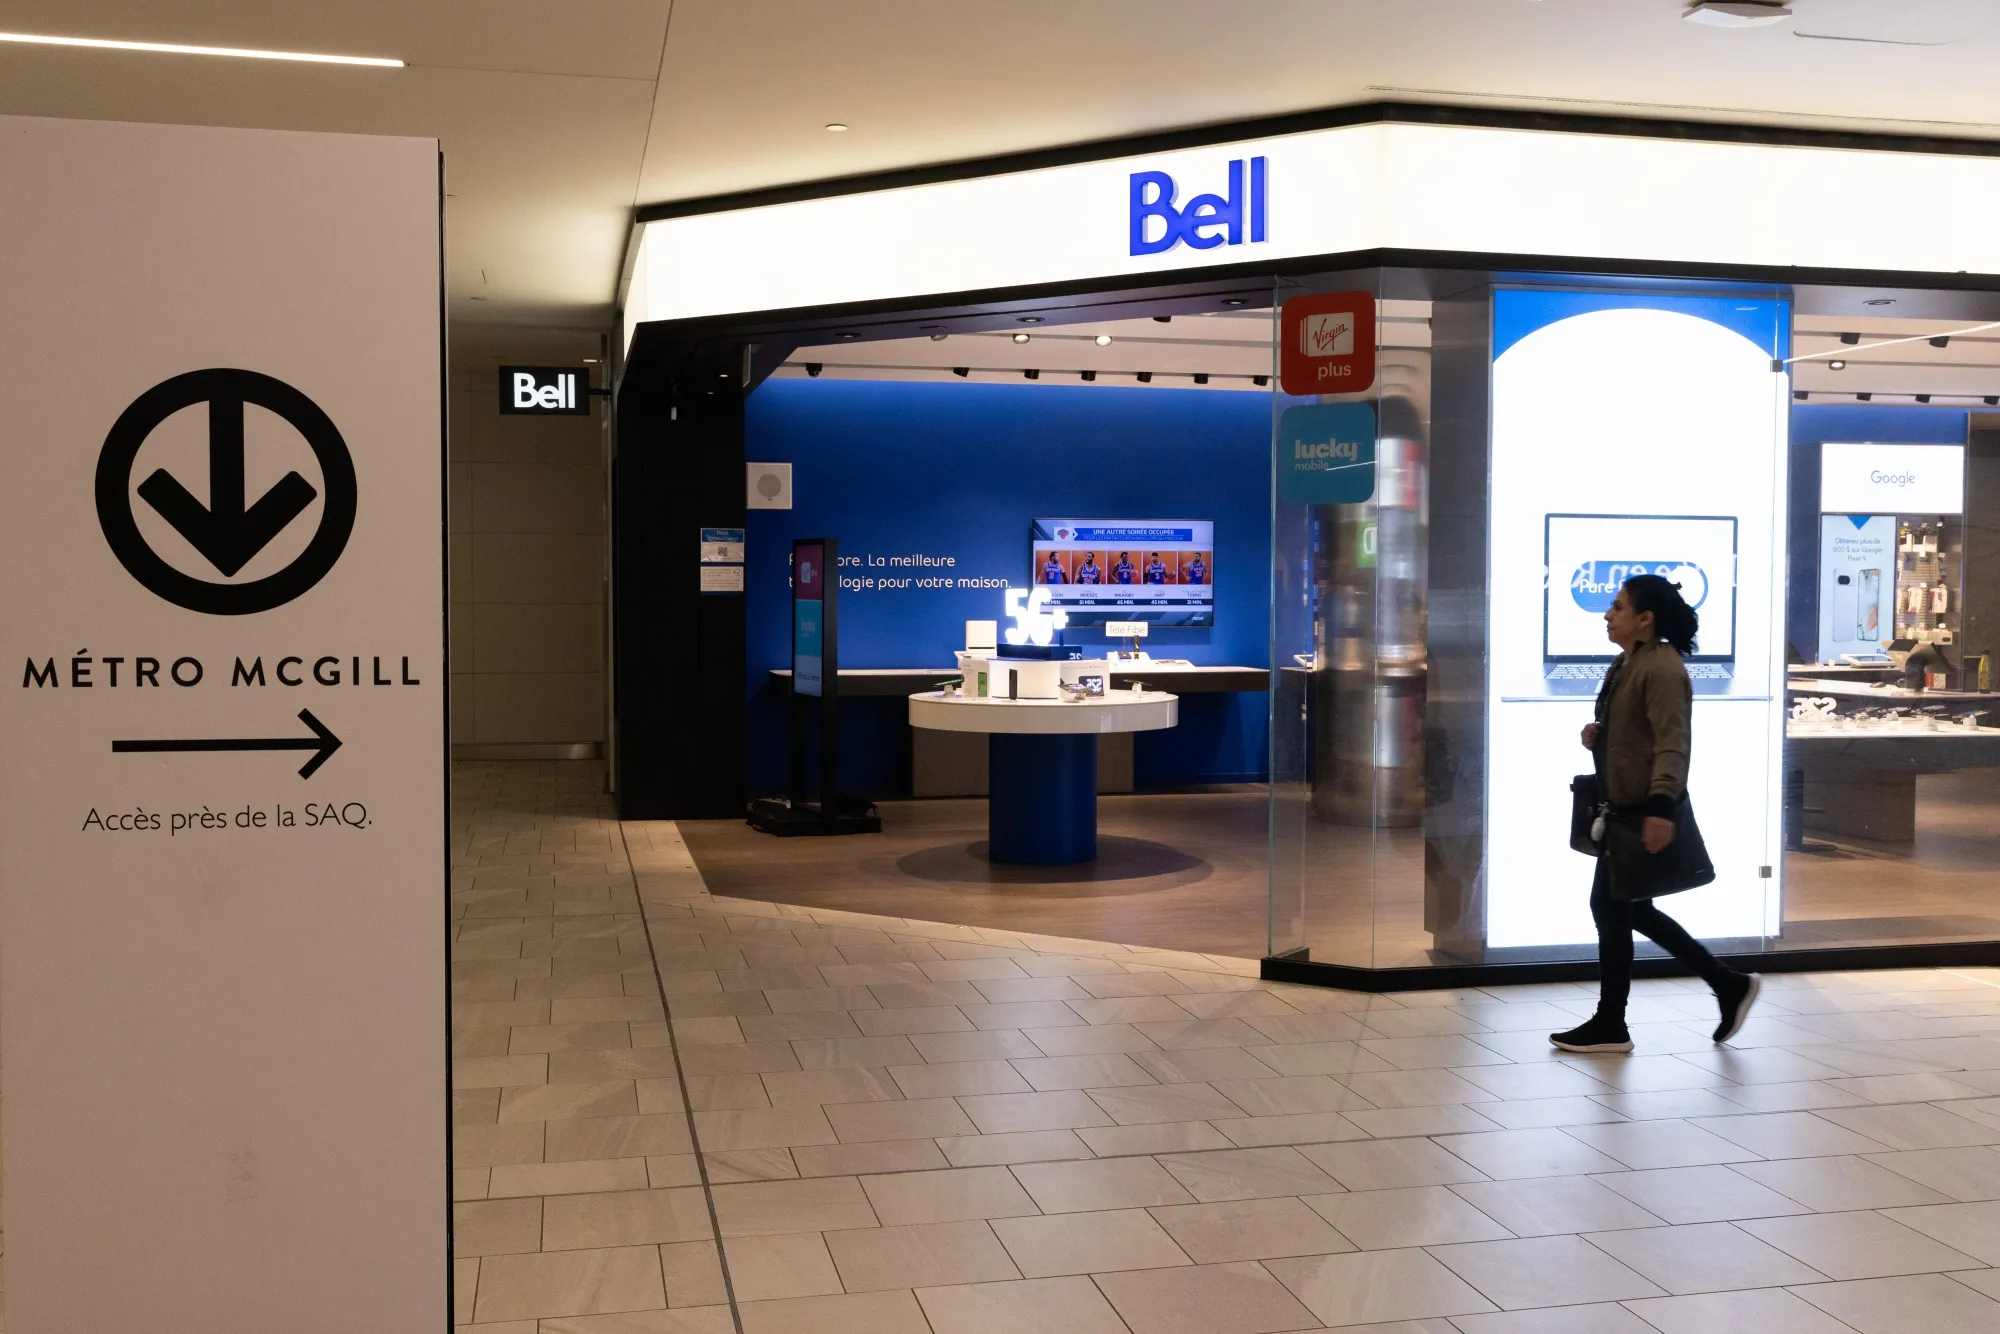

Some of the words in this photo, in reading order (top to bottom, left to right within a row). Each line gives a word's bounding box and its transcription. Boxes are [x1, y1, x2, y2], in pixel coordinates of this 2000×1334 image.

[1130, 156, 1269, 256] Bell
[1313, 318, 1348, 350] Virgin
[1318, 361, 1352, 380] plus
[513, 372, 576, 409] Bell
[1294, 438, 1358, 461] lucky
[1294, 460, 1329, 471] mobile
[1871, 470, 1915, 487] Google
[868, 554, 885, 567] La
[890, 554, 956, 567] meilleure
[878, 577, 911, 591] pour
[916, 576, 953, 589] votre
[957, 576, 1012, 589] maison.
[1580, 578, 1615, 593] Pure
[22, 647, 204, 688] MÉTRO
[231, 656, 420, 687] MCGILL
[82, 806, 161, 831] Accès
[170, 805, 227, 836] près
[235, 805, 267, 828] de
[276, 803, 296, 827] la
[305, 802, 373, 829] SAQ.
